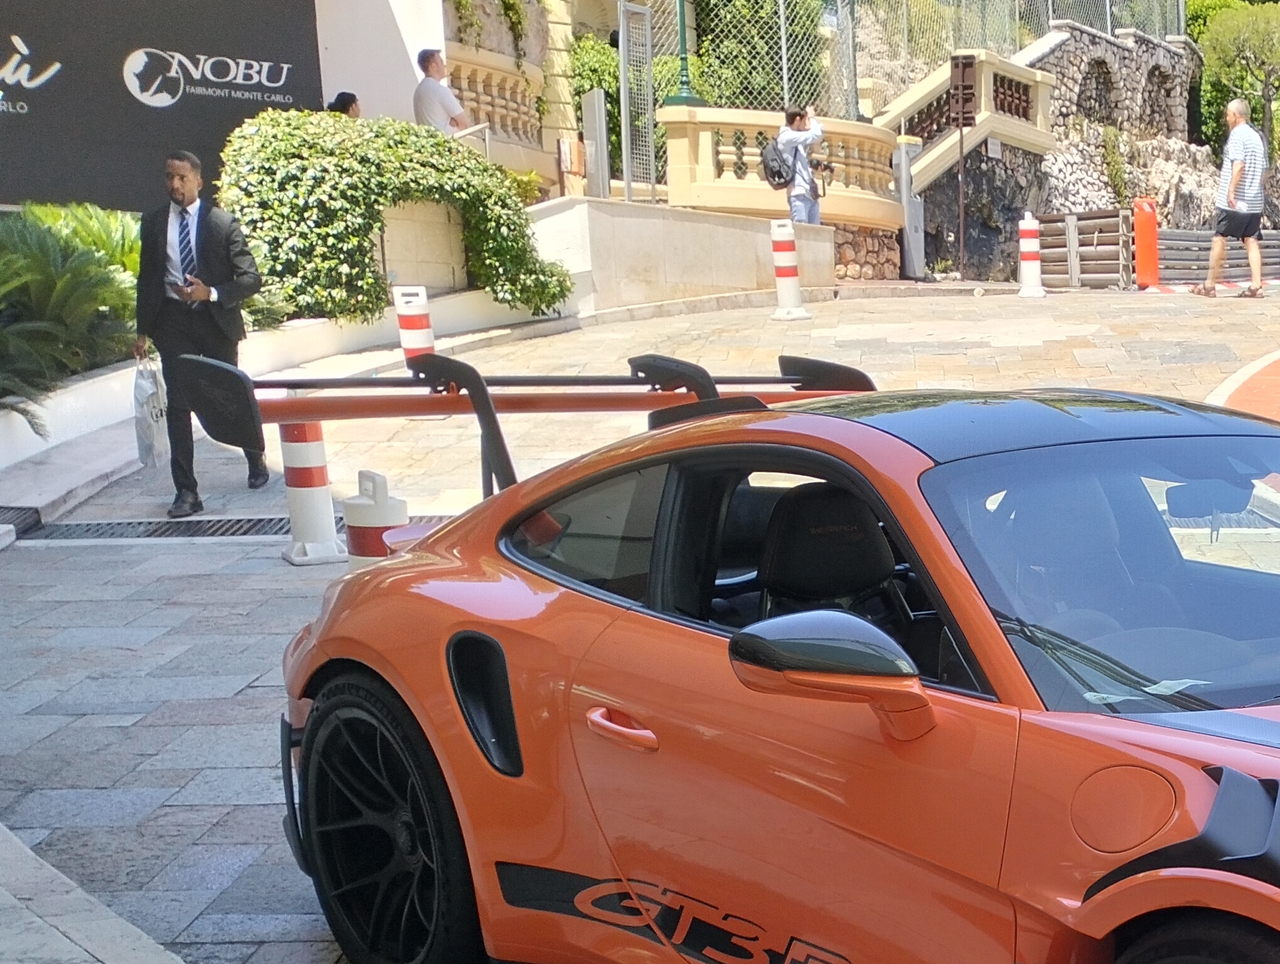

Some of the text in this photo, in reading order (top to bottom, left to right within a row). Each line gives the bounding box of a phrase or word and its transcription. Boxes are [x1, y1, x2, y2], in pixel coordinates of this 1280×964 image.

[166, 51, 292, 88] NOBU
[185, 85, 293, 103] FAIRMONT MONTE CARLO
